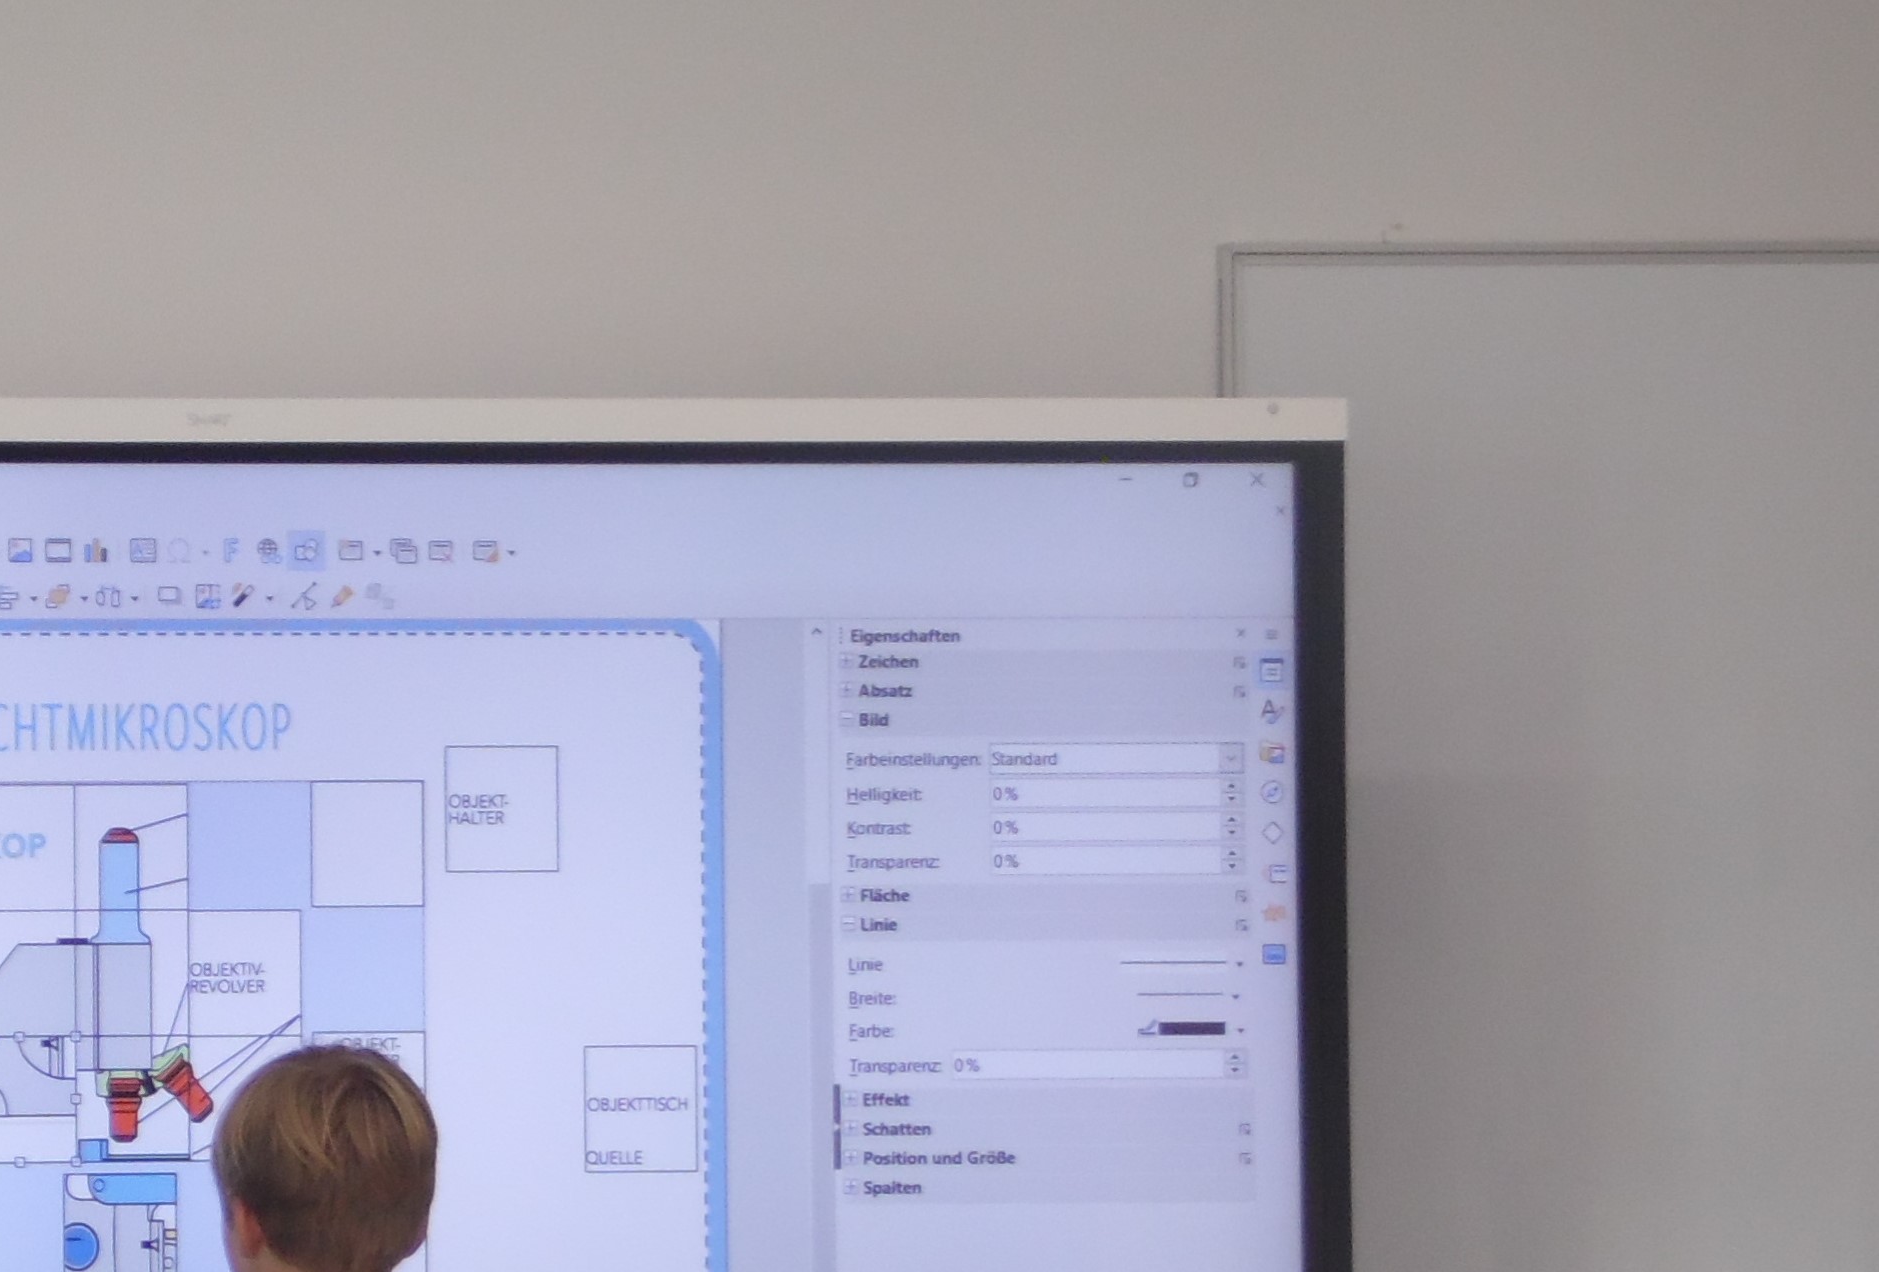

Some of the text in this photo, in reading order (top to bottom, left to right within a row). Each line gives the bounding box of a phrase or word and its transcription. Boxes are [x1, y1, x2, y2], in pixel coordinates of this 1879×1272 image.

[851, 629, 960, 645] Eigenschaften
[859, 655, 919, 669] Zeichen
[858, 684, 913, 698] Absatz
[859, 713, 889, 727] Bild
[992, 751, 1058, 766] Standard
[448, 794, 510, 809] OBJEKT-
[448, 810, 505, 825] HALTER
[860, 888, 909, 902] Fläche
[860, 918, 897, 931] Linie
[190, 963, 265, 977] OBJEKTIV-
[190, 979, 265, 994] REVOLVER
[586, 1097, 689, 1113] OBJEKTTISCH
[863, 1093, 909, 1106] Effekt
[863, 1122, 931, 1136] Schatten
[585, 1150, 643, 1166] QUELLE
[863, 1151, 1016, 1165] Position und Größe
[863, 1181, 922, 1196] Spalten
